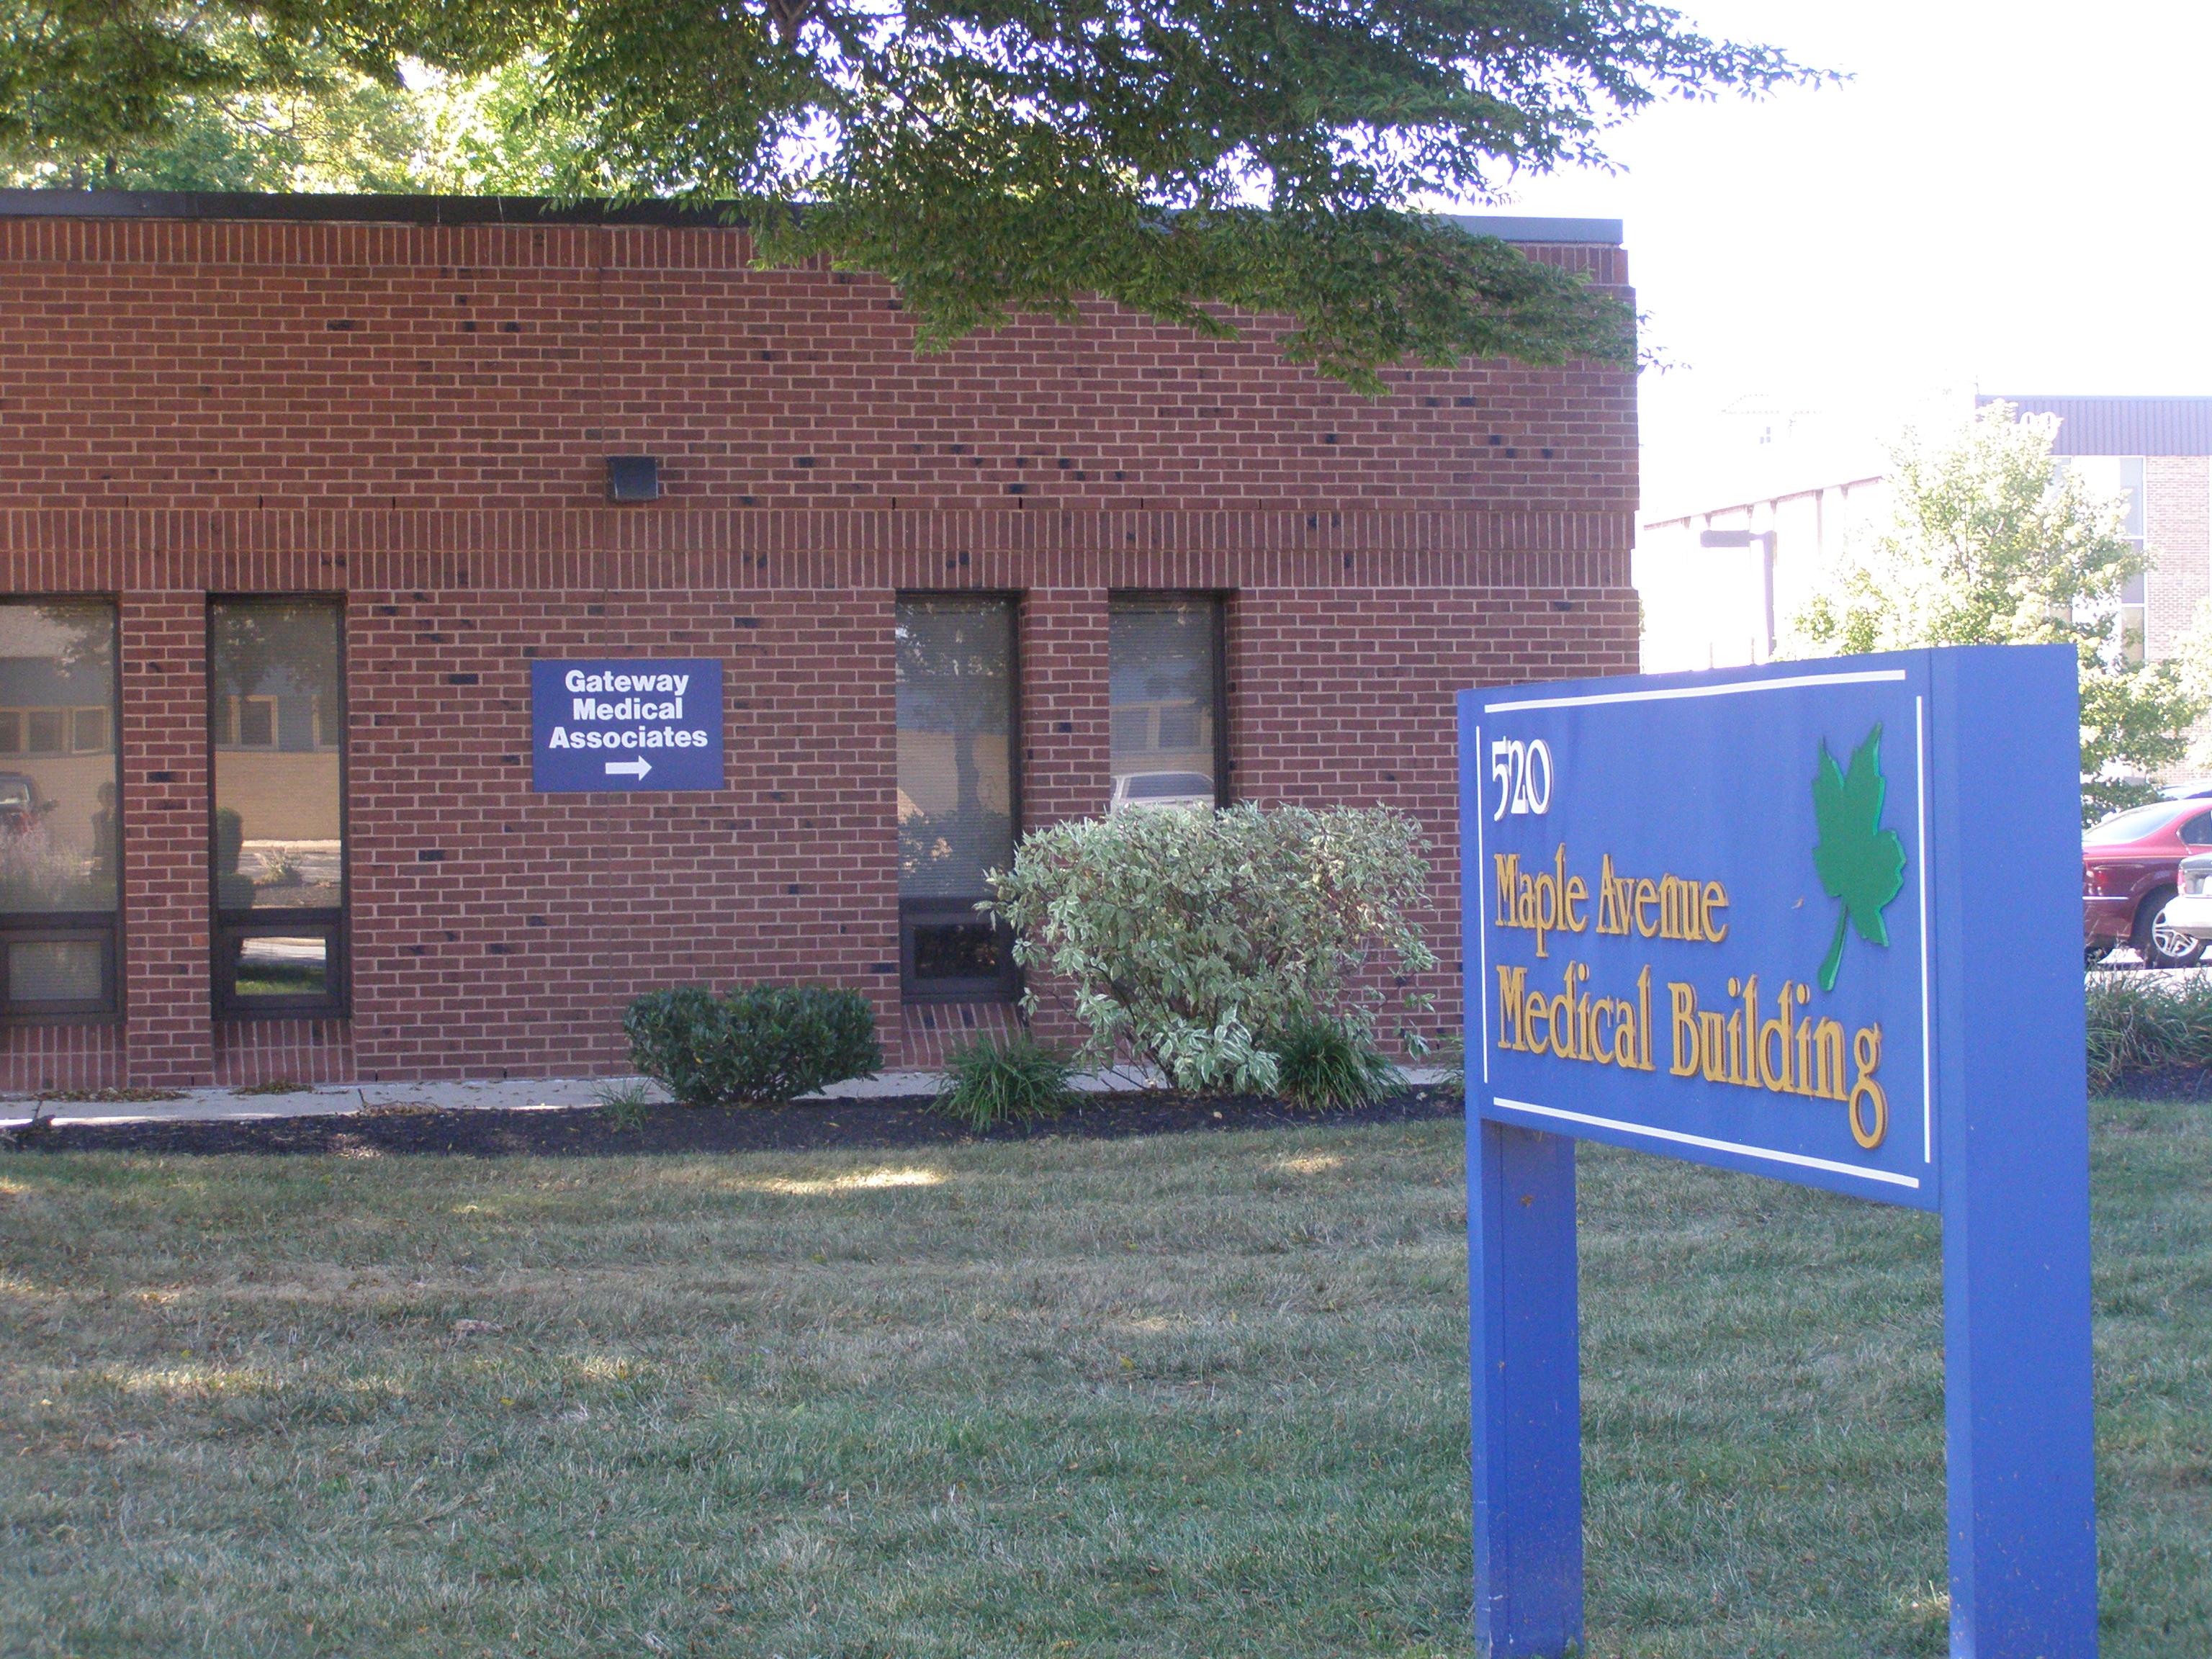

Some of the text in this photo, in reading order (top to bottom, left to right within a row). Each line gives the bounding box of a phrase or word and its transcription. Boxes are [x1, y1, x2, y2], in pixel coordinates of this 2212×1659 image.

[565, 670, 689, 696] Gateway
[573, 697, 683, 720] Medical
[549, 726, 708, 749] Associates
[1491, 736, 1554, 821] 520
[1493, 842, 1730, 958] Maple Avenue
[1496, 961, 1888, 1149] Medical Building
